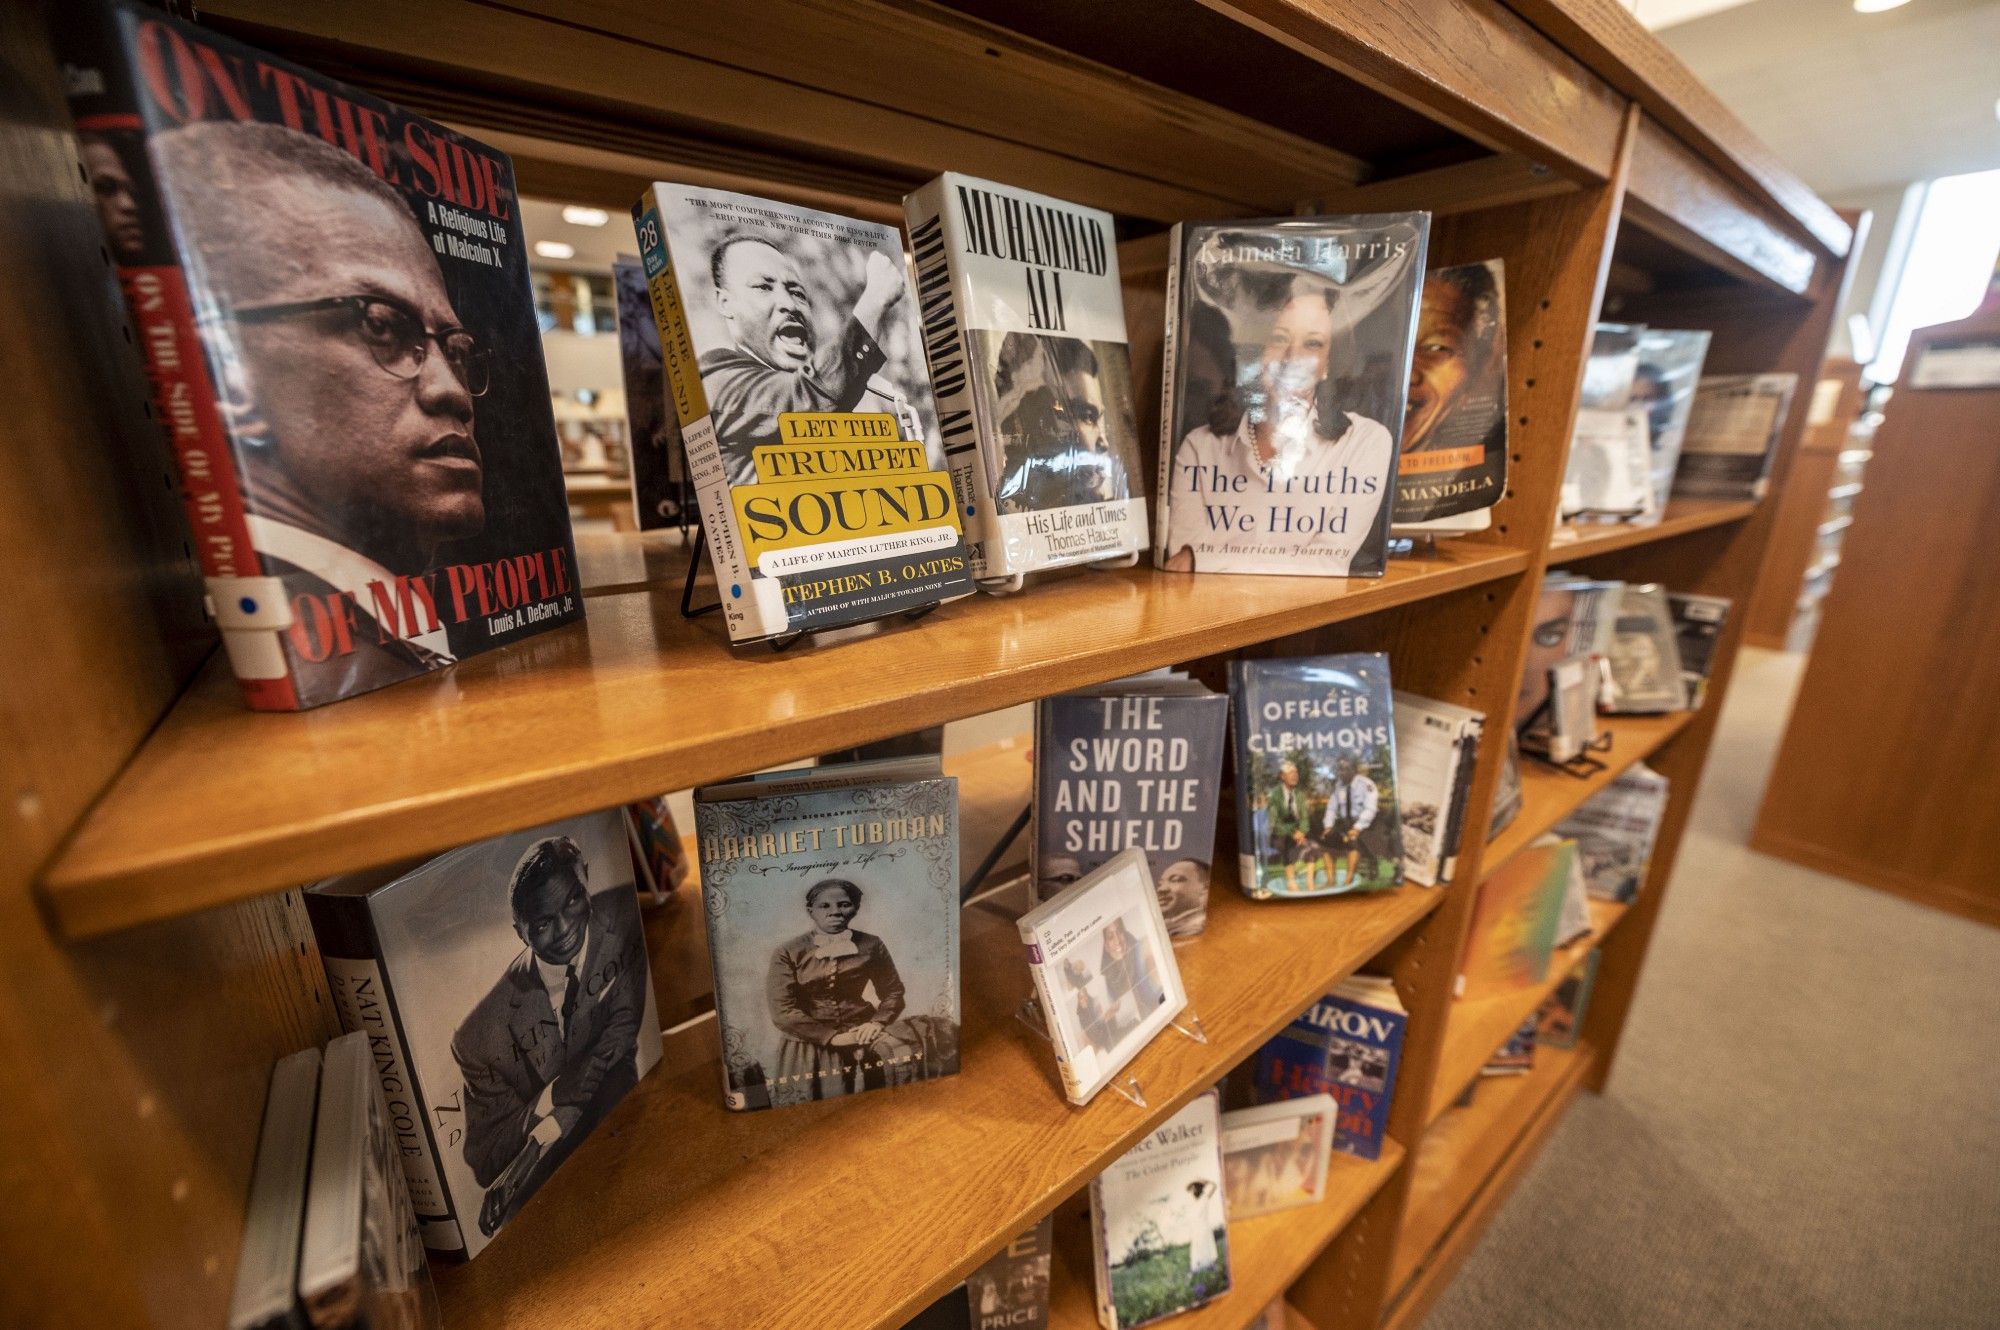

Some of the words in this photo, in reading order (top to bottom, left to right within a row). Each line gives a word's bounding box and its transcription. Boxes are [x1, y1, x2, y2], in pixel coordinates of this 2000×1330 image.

[136, 20, 254, 121] ON
[257, 63, 399, 186] THE
[404, 122, 509, 221] SIDE
[427, 201, 438, 225] A
[438, 204, 488, 239] Religious
[488, 220, 507, 245] Life
[709, 201, 733, 211] MOST
[735, 205, 801, 223] COMPREHENSIVE
[640, 220, 658, 253] 28
[770, 221, 789, 232] NEW
[789, 224, 809, 236] YORK
[810, 229, 832, 240] TIMES
[956, 184, 1107, 277] MUHAMMAD
[433, 231, 446, 254] of
[447, 234, 493, 266] Malcolm
[493, 247, 503, 268] X
[1025, 267, 1067, 331] ALI
[651, 278, 672, 334] MPET
[667, 341, 690, 416] SOUND
[673, 317, 691, 362] THE
[910, 214, 967, 398] MUHAMMAD
[940, 409, 977, 456] ALI
[788, 419, 838, 438] LET
[843, 419, 892, 437] THE
[688, 440, 714, 457] MARTIN
[691, 452, 718, 469] LUTHER
[761, 447, 921, 477] TRUMPET
[953, 467, 965, 505] Hauser
[963, 463, 977, 503] Thomas
[1184, 465, 1248, 493] The
[1260, 466, 1378, 495] Truths
[1401, 475, 1495, 501] MANDELA
[714, 490, 736, 561] STEPHEN
[744, 483, 951, 543] SOUND
[1026, 513, 1049, 535] His
[1051, 510, 1073, 533] Life
[1075, 511, 1096, 528] and
[1096, 506, 1127, 524] Times
[1204, 506, 1255, 533] We
[1266, 506, 1348, 534] Hold
[708, 513, 726, 565] OATES
[772, 560, 779, 568] A
[781, 555, 809, 567] LIFE
[810, 552, 825, 562] OF
[827, 545, 868, 560] MARTIN
[869, 539, 909, 553] LUTHER
[937, 533, 952, 542] JR.
[1045, 533, 1086, 551] Thomas
[1195, 542, 1214, 554] An
[1219, 542, 1288, 555] American
[1292, 543, 1350, 558] Journey
[781, 572, 873, 604] TEPHEN
[877, 569, 898, 587] B.
[901, 556, 965, 581] OATES
[289, 591, 358, 663] OF
[366, 573, 443, 645] MY
[445, 547, 573, 624] PEOPLE
[807, 603, 838, 616] AUTHOR
[839, 601, 850, 610] OF
[851, 597, 870, 607] WITH
[896, 586, 924, 597] TOWARD
[924, 581, 943, 592] NONE
[488, 614, 515, 637] Louis
[516, 611, 526, 628] A.
[527, 602, 563, 622] DeCaro,
[564, 596, 574, 611] Jr.
[728, 612, 744, 621] King
[1100, 696, 1165, 730] THE
[1263, 696, 1369, 721] OFFICER
[1069, 737, 1189, 773] SWORD
[1247, 725, 1388, 753] CLEMMONS
[1054, 779, 1122, 813] AND
[1136, 778, 1200, 813] THE
[704, 827, 824, 863] HARRIET
[832, 814, 946, 848] TUBMAN
[1065, 819, 1183, 852] SHIELD
[780, 859, 840, 877] Imagining
[841, 859, 849, 867] a
[856, 852, 876, 870] Life
[1301, 1003, 1395, 1043] ARON
[350, 975, 384, 1028] NAT
[367, 1034, 403, 1093] KING
[388, 1100, 423, 1158] COLE
[766, 1065, 853, 1087] BEVERLY
[864, 1051, 925, 1070] LOWRY
[1156, 1123, 1204, 1146] Walker
[980, 1305, 1039, 1330] PRICE
